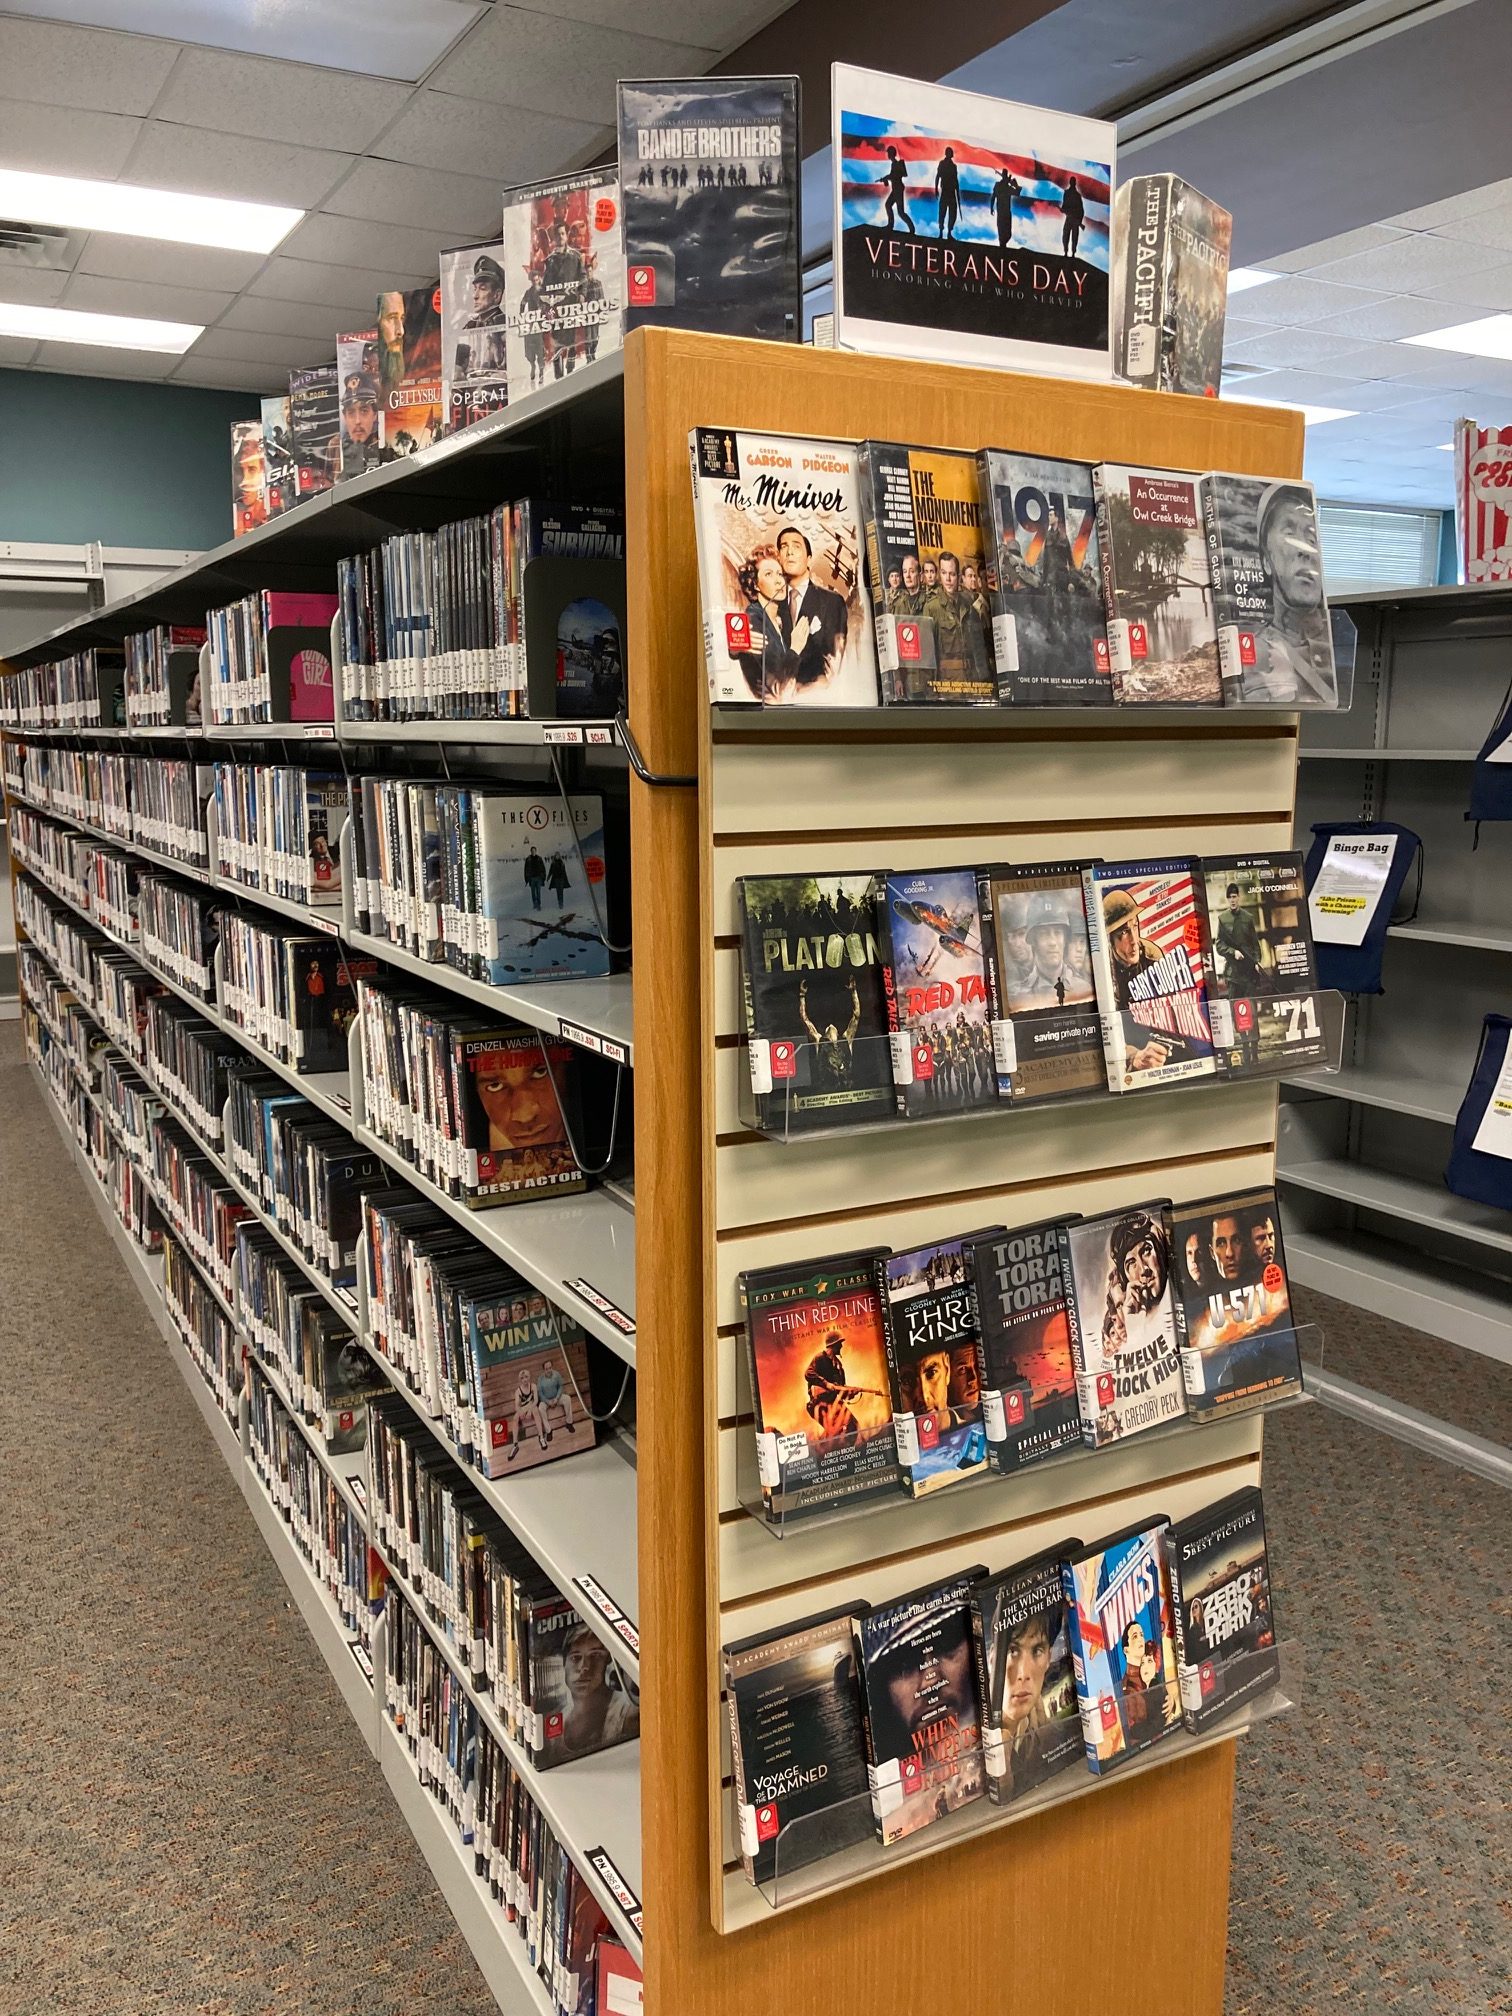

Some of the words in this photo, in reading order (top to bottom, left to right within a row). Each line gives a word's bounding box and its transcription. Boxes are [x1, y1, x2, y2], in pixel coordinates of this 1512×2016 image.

[637, 128, 682, 160] BAND
[682, 127, 698, 159] OF
[698, 125, 782, 159] BROTHERS
[543, 184, 568, 196] QUENTIN
[569, 177, 603, 190] TARANTINO
[1145, 187, 1160, 226] THE
[1172, 224, 1187, 242] THE
[1186, 231, 1227, 271] PACIFIC
[865, 236, 1020, 287] VETERANS
[1032, 264, 1088, 296] DAY
[545, 283, 562, 291] BRAD
[871, 268, 952, 289] HONORING
[962, 282, 985, 295] ALL
[994, 287, 1025, 300] WHO
[1032, 294, 1083, 309] SERVED
[518, 312, 609, 337] BASTERDS
[292, 372, 317, 388] WIDE
[389, 386, 442, 409] GETTYSBU
[452, 387, 506, 406] OPERAT
[746, 453, 792, 469] GARSON
[802, 458, 849, 474] PIDGEON
[721, 483, 756, 512] Mrs.
[753, 473, 848, 515] Miniver
[912, 470, 936, 497] THE
[1136, 488, 1148, 499] An
[1148, 487, 1189, 504] Occurrence
[1133, 506, 1149, 520] Owl
[1151, 511, 1173, 523] Creek
[1174, 513, 1196, 527] Bridge
[1160, 503, 1169, 511] at
[1204, 495, 1216, 529] PATHS
[917, 521, 944, 549] MEN
[993, 483, 1098, 571] 1917
[1209, 534, 1217, 549] OF
[541, 531, 624, 560] SURVIVAL
[1211, 555, 1222, 591] GLORY
[1233, 569, 1264, 583] PATHS
[1234, 583, 1249, 595] OF
[1236, 597, 1267, 610] GLORY
[1072, 677, 1088, 685] FILMS
[545, 732, 553, 741] PN
[320, 792, 337, 806] THE
[501, 811, 525, 825] THE
[533, 810, 542, 825] X
[1333, 843, 1365, 854] Binge
[1366, 843, 1389, 854] Bag
[911, 880, 926, 888] CUBA
[1098, 868, 1132, 877] TWO-DISC
[1135, 866, 1162, 874] SPECIAL
[903, 886, 927, 894] GOODING
[1247, 884, 1264, 893] JACK
[1265, 881, 1299, 892] O'CONNELL
[762, 931, 882, 974] PLATOON
[882, 966, 894, 995] RED
[987, 957, 996, 986] saving
[1128, 970, 1155, 1001] GARY
[1148, 944, 1195, 997] COOPER
[905, 981, 955, 1017] RED
[885, 999, 900, 1032] TAILS
[1128, 994, 1176, 1033] SERGEANT
[1167, 988, 1211, 1041] YORK
[466, 1040, 505, 1054] DENZEL
[563, 1025, 571, 1036] PN
[605, 1044, 621, 1058] SCI-FI
[1033, 1029, 1060, 1043] saving
[1060, 1027, 1082, 1040] private
[1081, 1025, 1096, 1037] ryan
[477, 1179, 522, 1196] BEST
[524, 1170, 583, 1188] ACTOR
[992, 1229, 1058, 1267] TORA
[995, 1252, 1061, 1291] TORA
[1061, 1258, 1074, 1295] TWELVE
[570, 1281, 581, 1289] PN
[607, 1312, 633, 1330] SPORTS
[755, 1292, 776, 1303] FOX
[782, 1287, 804, 1297] WAR
[904, 1299, 937, 1313] CLOONEY
[998, 1276, 1064, 1315] TORA
[1208, 1282, 1268, 1329] U-571
[768, 1311, 807, 1333] THIN
[812, 1304, 839, 1325] RED
[844, 1296, 876, 1317] LINE
[832, 1323, 848, 1332] FILM
[1066, 1297, 1079, 1344] O'CLOCK
[484, 1325, 530, 1353] WIN
[883, 1322, 895, 1368] KINGS
[1072, 1343, 1083, 1372] HIGH
[1113, 1334, 1169, 1376] TWELVE
[1124, 1397, 1158, 1428] GREGORY
[1160, 1391, 1180, 1414] PECK
[786, 1435, 796, 1443] Not
[865, 1446, 880, 1455] JOHN
[1018, 1429, 1052, 1451] SPECIAL
[820, 1457, 839, 1467] GEORGE
[840, 1451, 861, 1463] CLOONEY
[823, 1449, 840, 1459] ADRIEN
[800, 1471, 820, 1481] WOODY
[820, 1463, 848, 1475] HARRELSON
[812, 1477, 824, 1485] NICK
[824, 1473, 839, 1482] NOLTE
[853, 1465, 867, 1474] JOHN
[801, 1489, 844, 1505] INCLUDING
[847, 1482, 864, 1492] BEST
[867, 1473, 898, 1486] PICTURE
[801, 1485, 830, 1498] ACADEMY
[1182, 1543, 1191, 1561] 5
[1190, 1538, 1212, 1557] BEST
[1216, 1513, 1257, 1543] PICTURE
[1169, 1566, 1181, 1602] ZERO
[1202, 1570, 1251, 1612] ZERO
[581, 1579, 593, 1588] PN
[617, 1624, 639, 1647] SPORTS
[877, 1615, 890, 1629] war
[891, 1609, 913, 1628] picture
[912, 1604, 926, 1618] that
[926, 1600, 942, 1613] earns
[943, 1593, 951, 1606] its
[1002, 1604, 1019, 1617] THE
[1019, 1588, 1048, 1608] WIND
[1103, 1552, 1155, 1651] WINGS
[1203, 1589, 1253, 1633] DARK
[993, 1610, 1029, 1633] SHAKES
[1029, 1602, 1046, 1616] THE
[1173, 1607, 1185, 1647] DARK
[1205, 1610, 1253, 1649] THIRTY
[743, 1646, 780, 1664] ACADEMY
[764, 1702, 774, 1711] VON
[727, 1698, 740, 1748] VOYAGE
[911, 1715, 960, 1752] WHEN
[775, 1749, 792, 1760] MASON
[753, 1764, 800, 1790] VOYAGE
[756, 1790, 765, 1799] OF
[766, 1764, 828, 1802] DAMNED
[594, 1857, 607, 1869] PN
[603, 1869, 621, 1890] 1995.9
